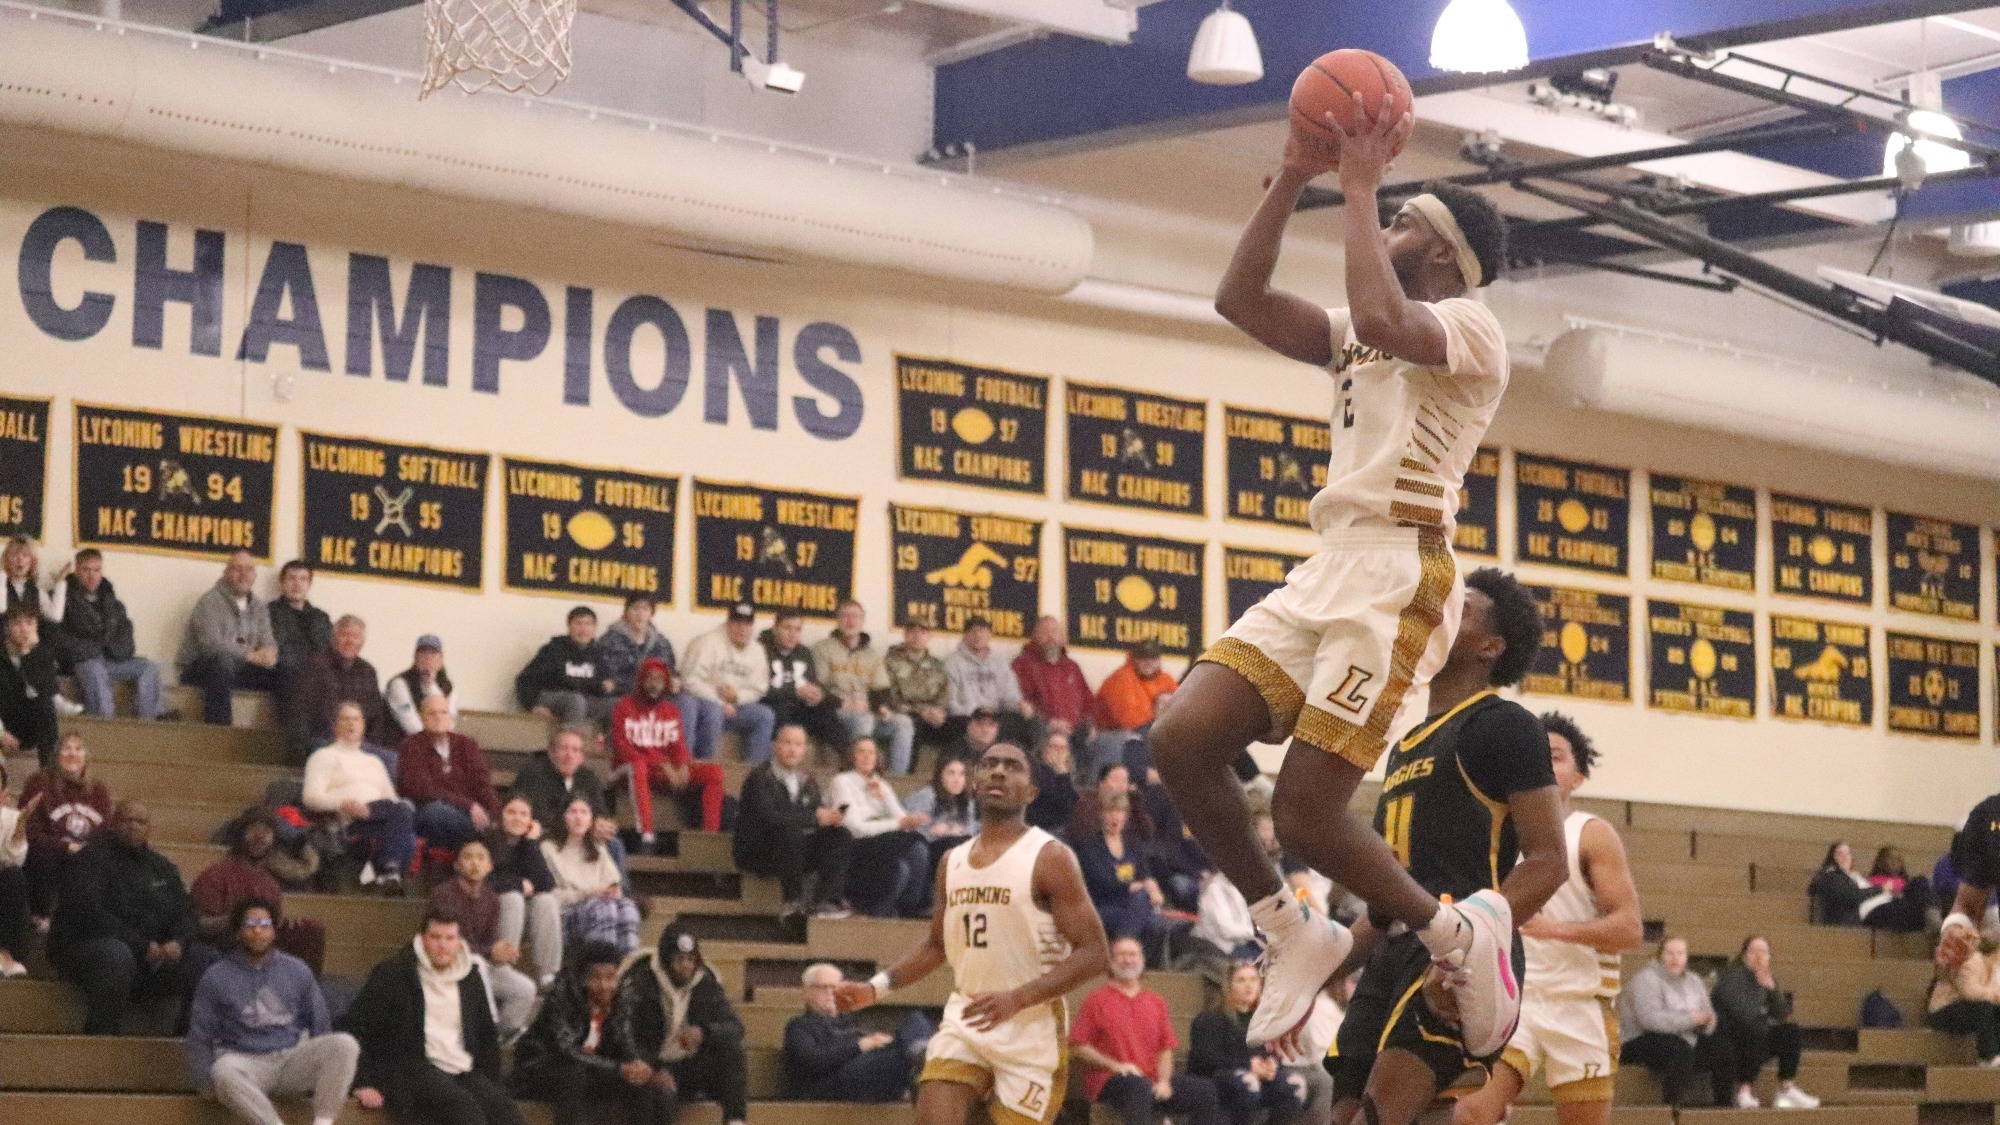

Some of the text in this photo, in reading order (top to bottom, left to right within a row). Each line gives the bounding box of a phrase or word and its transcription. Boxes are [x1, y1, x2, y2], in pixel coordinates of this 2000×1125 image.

[17, 206, 864, 440] CHAMPIONS
[901, 366, 1042, 410] LYCOMING FOOTBALL
[81, 415, 272, 462] LYCOMING WRESTLING
[931, 408, 947, 433] 19
[123, 464, 242, 502] 19 94
[309, 443, 479, 489] LYCOMING SOFTBALL
[953, 450, 1031, 483] CHAMPIONS
[509, 468, 671, 513] LYCOMING FOOTBALL
[1118, 473, 1191, 506] CHAMPIONS
[99, 507, 254, 548] MAC CHAMPIONS
[350, 494, 441, 529] 19 95
[542, 512, 561, 540] 19
[695, 491, 856, 532] LYCOMING WRESTLING
[321, 537, 463, 578] MAC CHAMPIONS
[736, 534, 818, 568] 19 97
[1013, 556, 1038, 583] 97
[523, 553, 658, 592] MAC CHAMPIONS
[711, 574, 837, 612] MAC CHAMPIONS
[1326, 664, 1373, 714] L
[948, 886, 1011, 907] LYCOMING
[963, 913, 988, 948] 12
